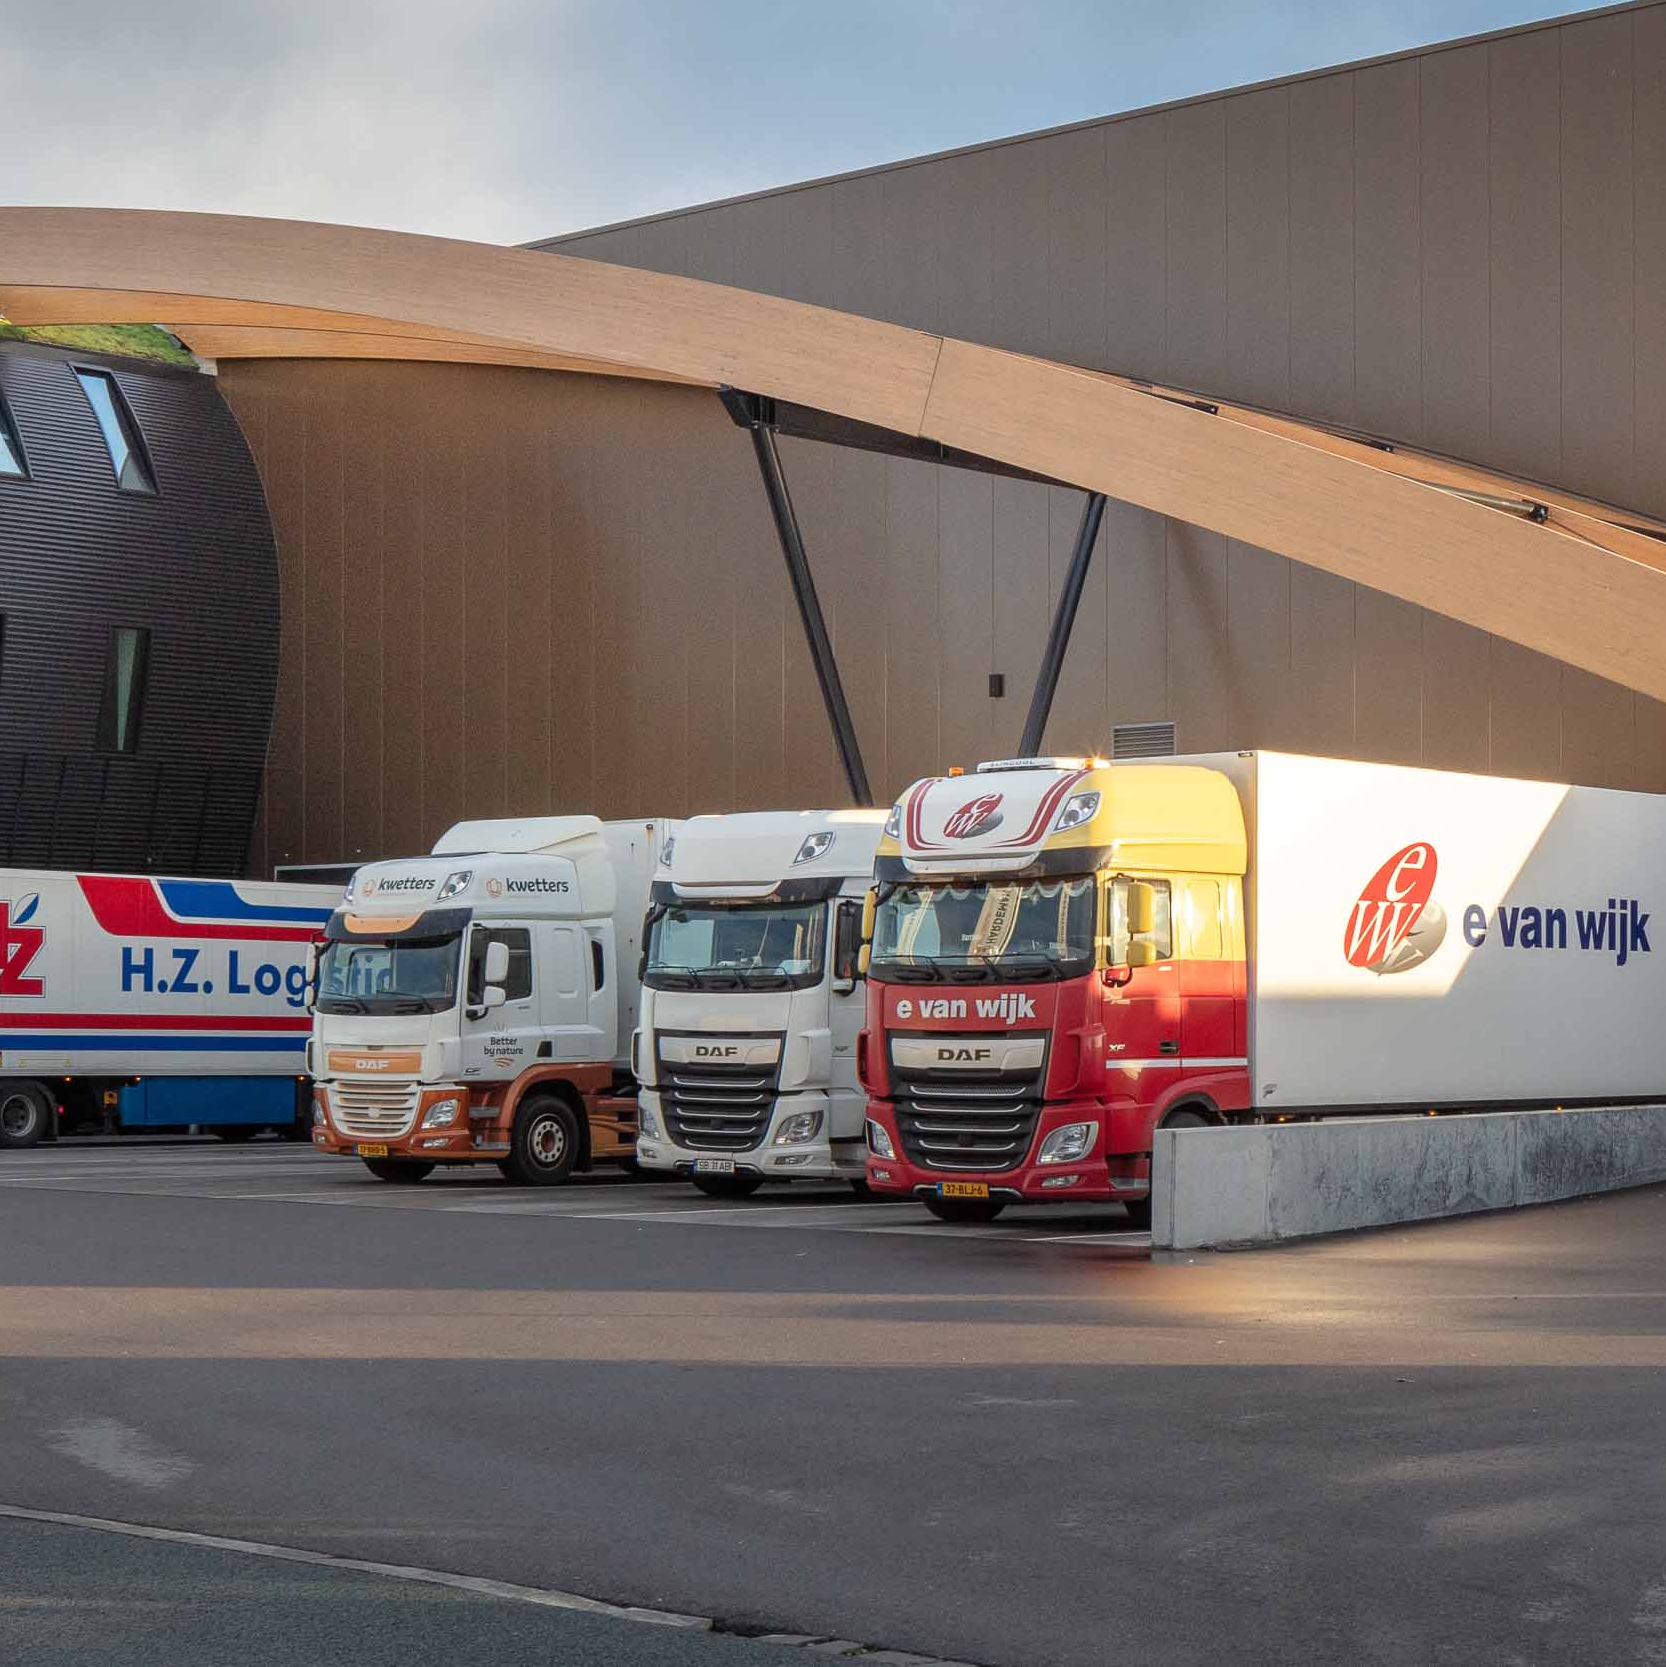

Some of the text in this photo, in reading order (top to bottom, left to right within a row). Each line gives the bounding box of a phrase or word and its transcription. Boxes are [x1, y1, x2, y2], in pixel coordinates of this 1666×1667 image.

[378, 877, 436, 891] kwetters
[506, 878, 569, 893] kwetters
[1463, 898, 1651, 967] e van wijk
[121, 946, 214, 994] H.Z.
[896, 993, 1037, 1025] e van wijk
[490, 1036, 518, 1046] Better
[484, 1045, 524, 1057] by nature
[695, 1046, 738, 1057] DAF
[938, 1049, 992, 1061] DAF
[355, 1059, 390, 1070] DAF
